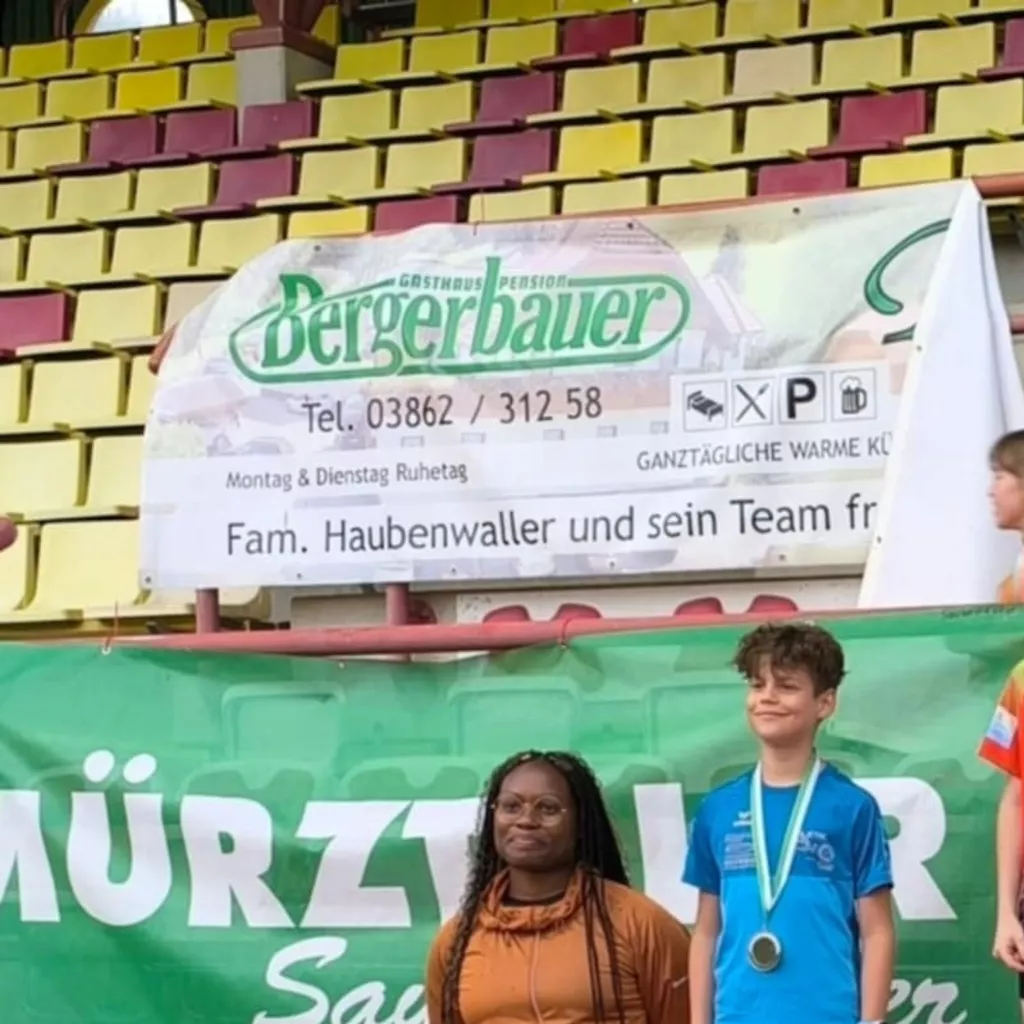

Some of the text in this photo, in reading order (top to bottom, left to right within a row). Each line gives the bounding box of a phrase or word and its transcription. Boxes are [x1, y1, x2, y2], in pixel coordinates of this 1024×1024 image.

[261, 257, 666, 376] Bergerbauer
[302, 403, 354, 433] Tel.
[366, 395, 454, 428] 03862
[499, 391, 553, 424] 312
[566, 386, 602, 419] 58
[787, 377, 817, 420] P
[226, 462, 469, 491] Montag & Dienstag Ruhetag
[636, 441, 783, 471] GANZTÄGLICHE
[789, 437, 861, 459] WARME
[226, 522, 308, 555] Fam.
[324, 510, 556, 553] Haubenwaller
[569, 506, 634, 542] und
[647, 503, 718, 539] sein
[730, 499, 831, 534] Team
